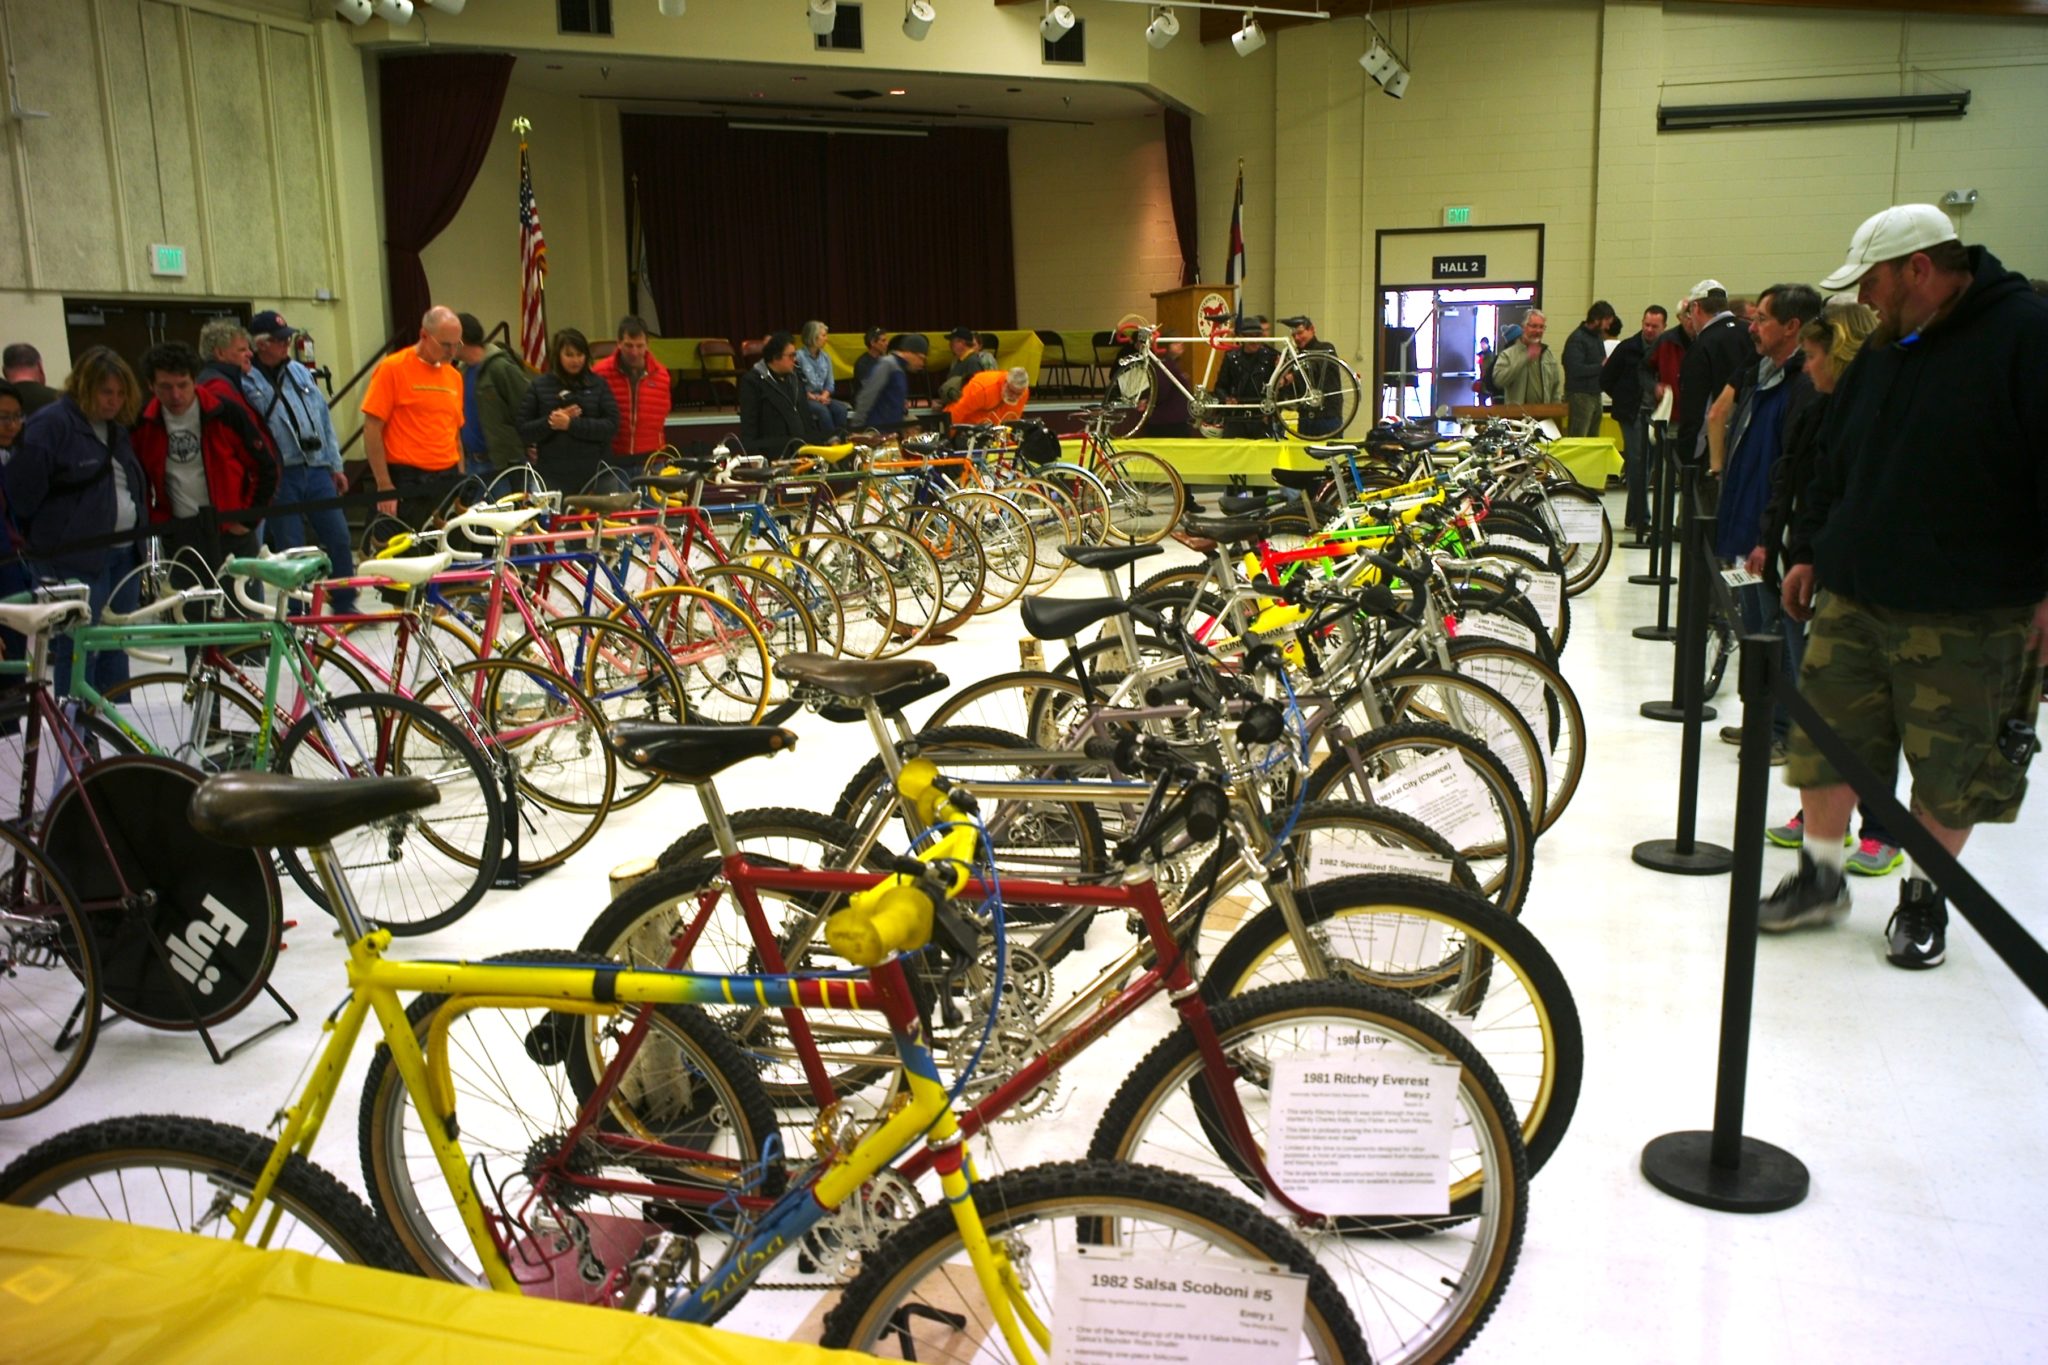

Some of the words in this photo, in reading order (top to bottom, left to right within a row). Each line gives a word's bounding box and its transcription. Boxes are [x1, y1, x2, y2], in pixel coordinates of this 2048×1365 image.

[1447, 208, 1470, 225] EXIT
[1440, 262, 1468, 273] HALL
[1471, 261, 1479, 272] 2
[1402, 779, 1418, 791] City
[1418, 761, 1453, 784] (Chance)
[1319, 857, 1339, 867] 1982
[1340, 859, 1388, 872] Specialized
[165, 893, 249, 996] Fuji
[1303, 1072, 1330, 1085] 1981
[1334, 1073, 1378, 1087] Ritchey
[1382, 1073, 1430, 1087] Everest
[1404, 1090, 1424, 1100] Entry
[1425, 1092, 1431, 1100] 2
[1090, 1273, 1128, 1290] 1982
[1132, 1276, 1177, 1293] Salsa
[1182, 1279, 1249, 1299] Scoboni
[1253, 1288, 1273, 1302] #5
[1240, 1308, 1266, 1321] Entry
[1268, 1313, 1274, 1321] 1
